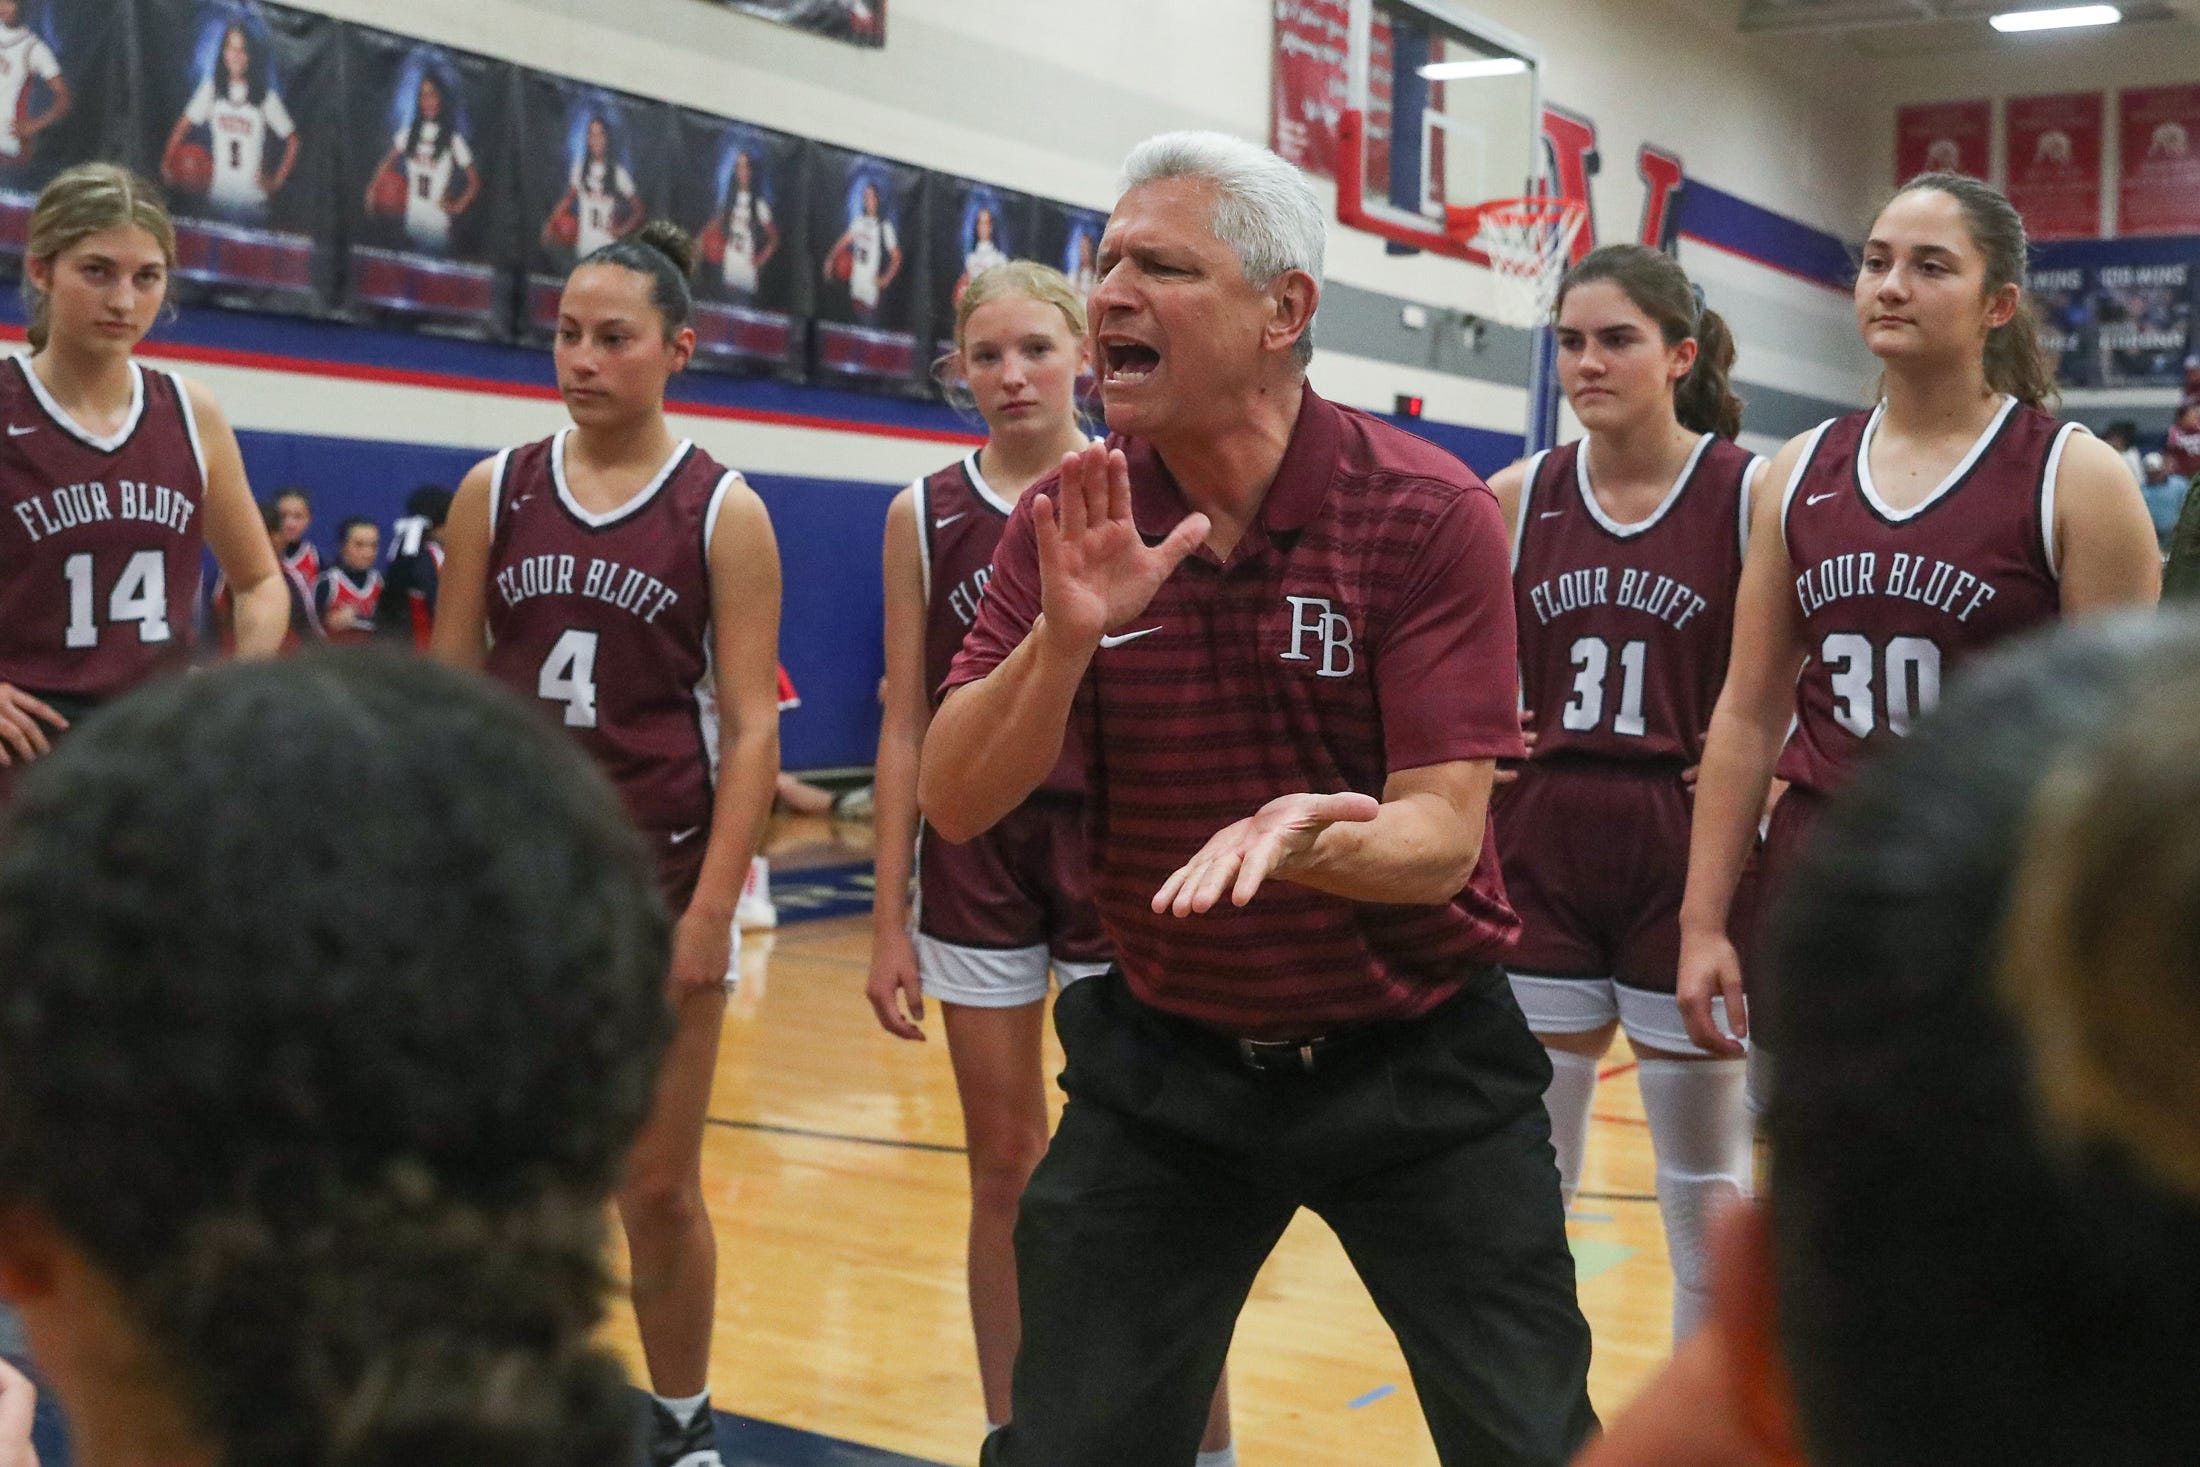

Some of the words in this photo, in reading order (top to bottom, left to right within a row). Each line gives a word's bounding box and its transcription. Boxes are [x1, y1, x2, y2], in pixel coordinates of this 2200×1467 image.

[2135, 263, 2188, 286] WINS
[13, 481, 114, 542] FLOUR
[119, 480, 195, 534] BLUFF
[64, 550, 171, 648] 14
[496, 554, 575, 608] FLOUR
[582, 558, 679, 624] BLUFF
[1530, 566, 1609, 626] FLOUR
[1615, 568, 1707, 631] BLUFF
[1796, 552, 1875, 618] FLOUR
[1885, 552, 1996, 622] BLUFF
[1280, 596, 1354, 677] FB
[538, 629, 599, 727] 4
[1562, 637, 1646, 736] 31
[1822, 633, 1941, 739] 30
